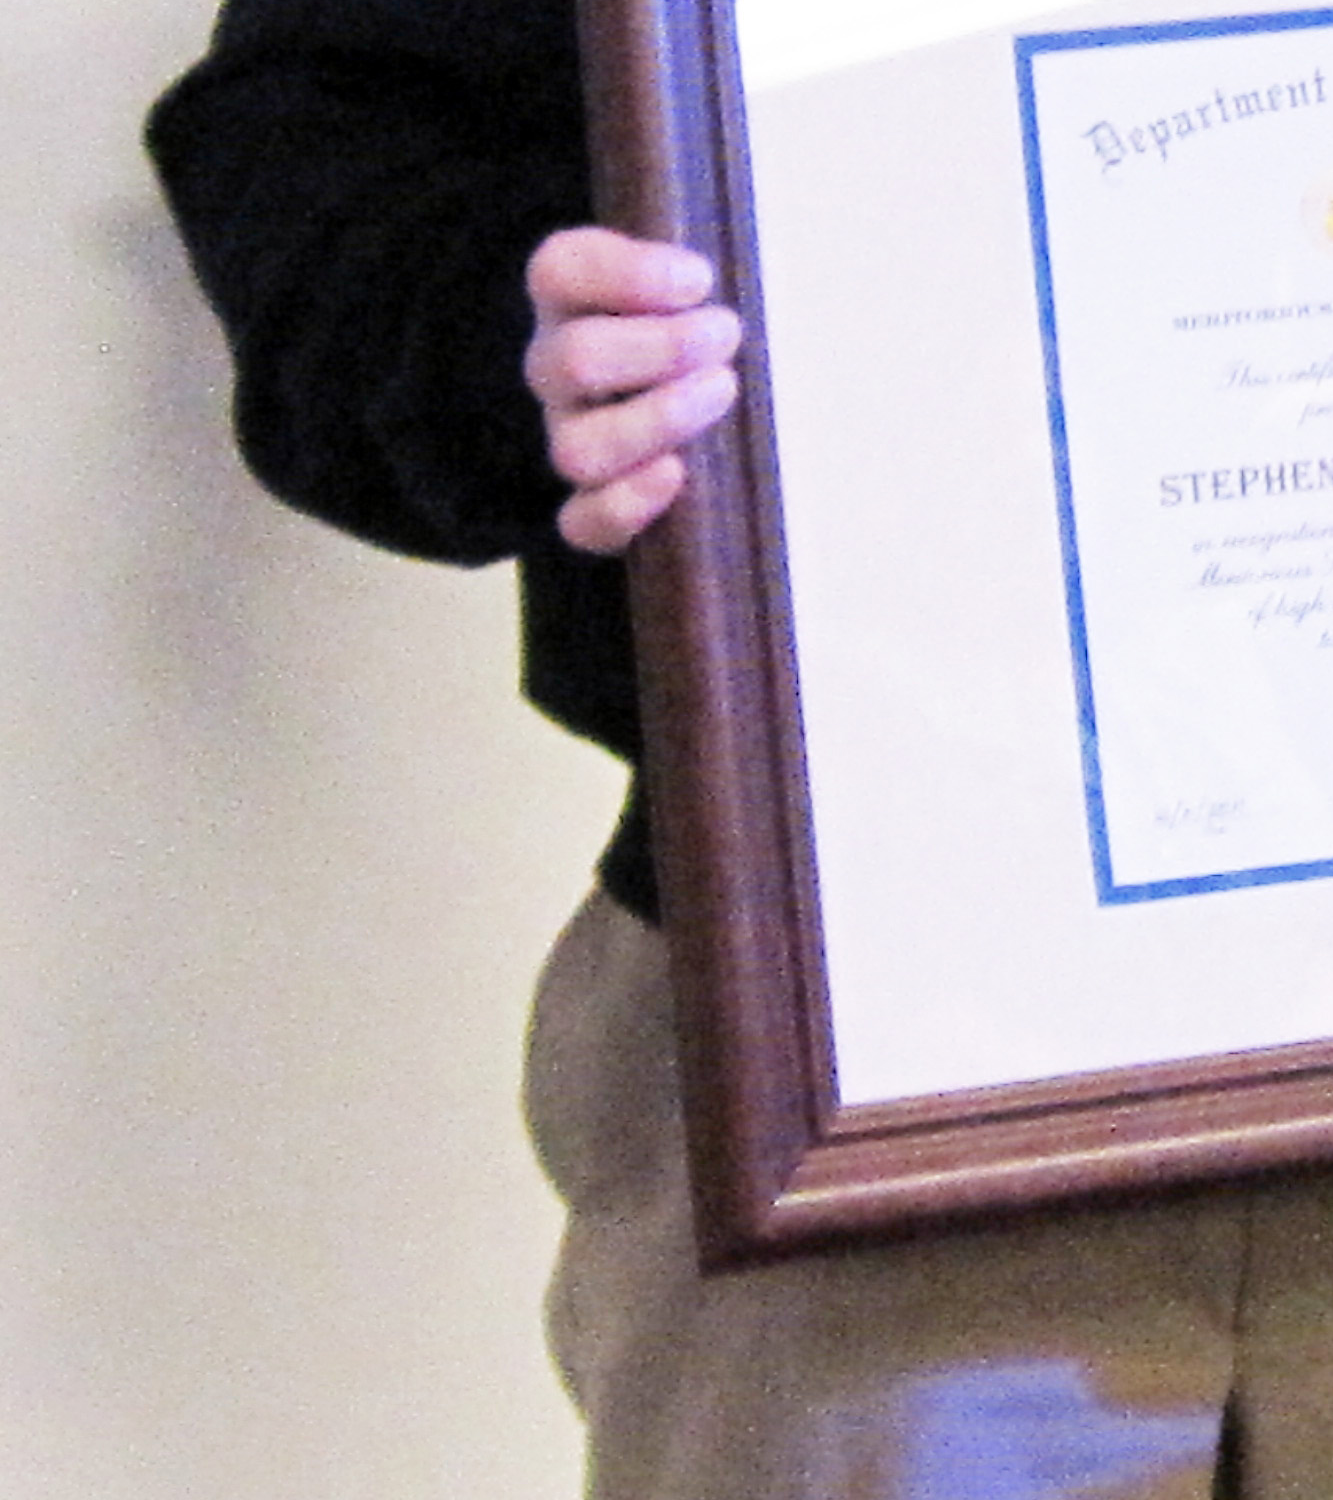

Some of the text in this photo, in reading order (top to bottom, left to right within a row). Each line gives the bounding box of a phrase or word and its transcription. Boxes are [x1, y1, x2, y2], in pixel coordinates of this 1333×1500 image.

[1081, 66, 1327, 175] Department
[1247, 591, 1275, 630] of
[1274, 585, 1325, 627] high
